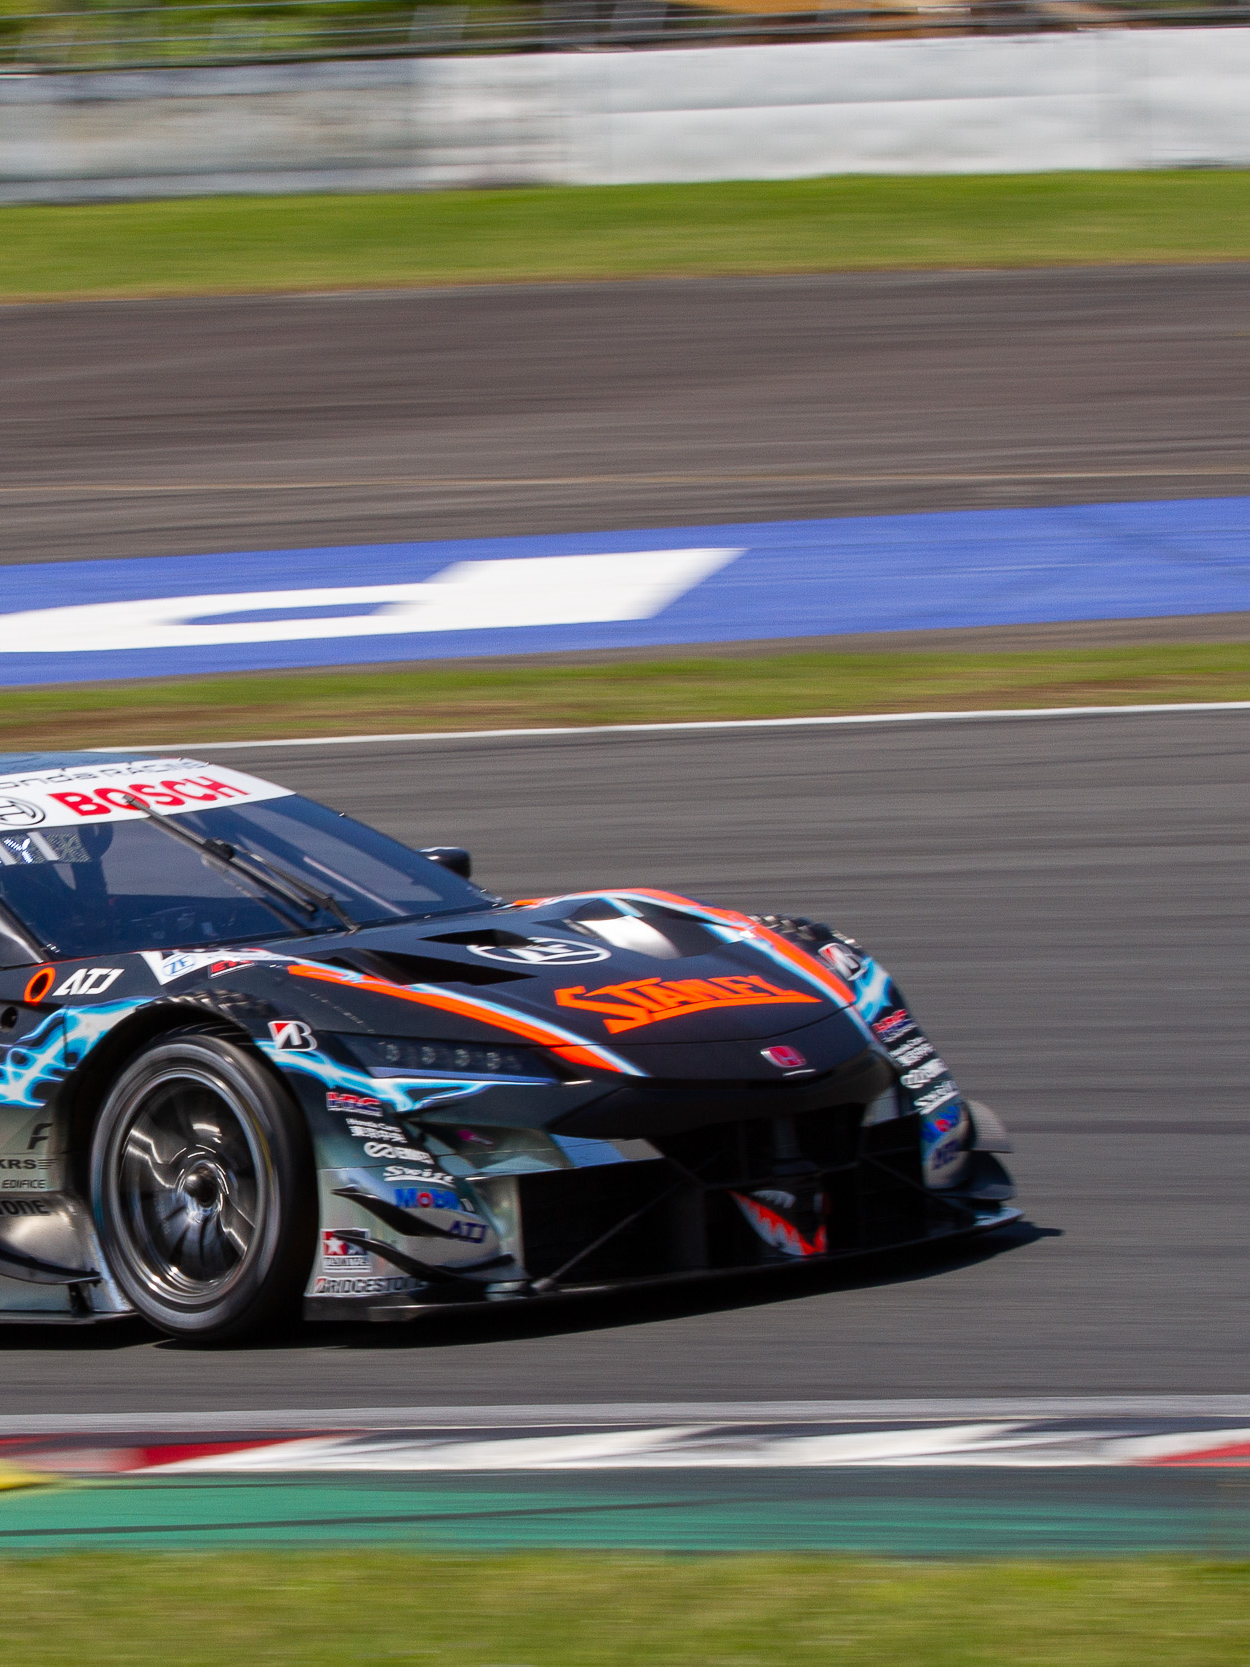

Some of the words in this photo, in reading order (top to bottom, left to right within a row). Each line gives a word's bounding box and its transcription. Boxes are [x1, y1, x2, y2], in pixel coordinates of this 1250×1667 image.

[48, 775, 250, 816] BOSCH
[554, 975, 823, 1034] STANLEY
[1, 1179, 46, 1189] EDIFICE
